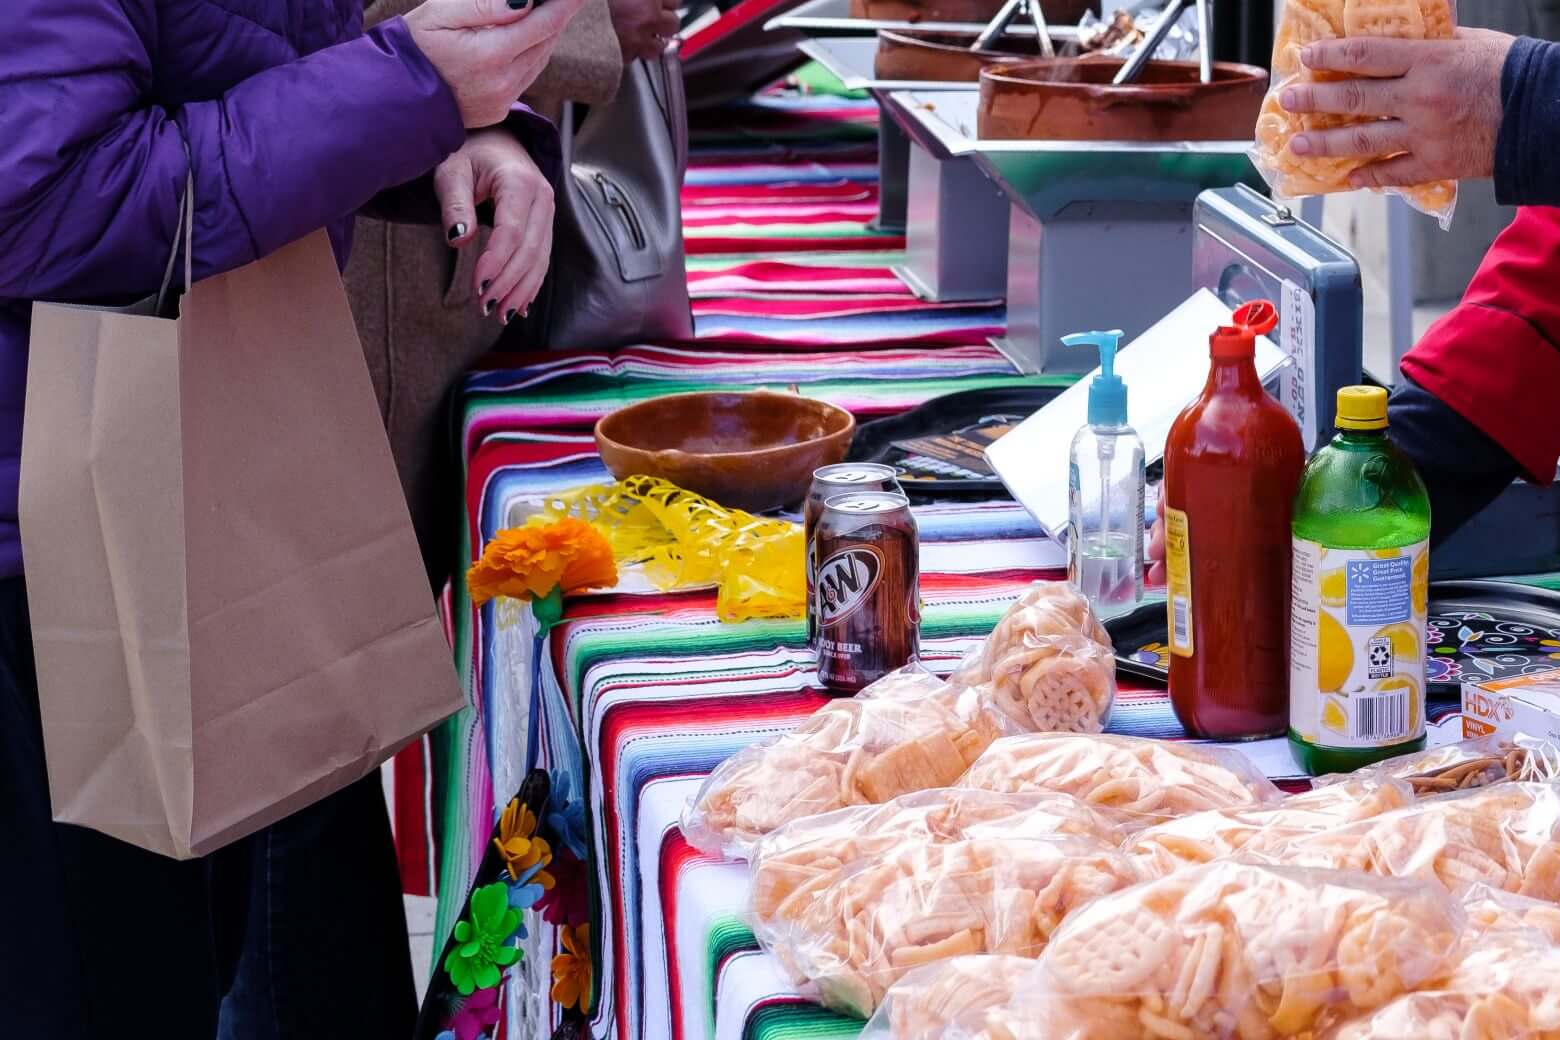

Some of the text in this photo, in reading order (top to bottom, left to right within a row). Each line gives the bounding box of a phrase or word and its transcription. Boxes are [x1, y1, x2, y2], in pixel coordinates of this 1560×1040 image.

[819, 551, 861, 615] A&W
[837, 640, 863, 653] BEER
[1465, 691, 1501, 723] HDX
[1465, 720, 1487, 735] VINYL
